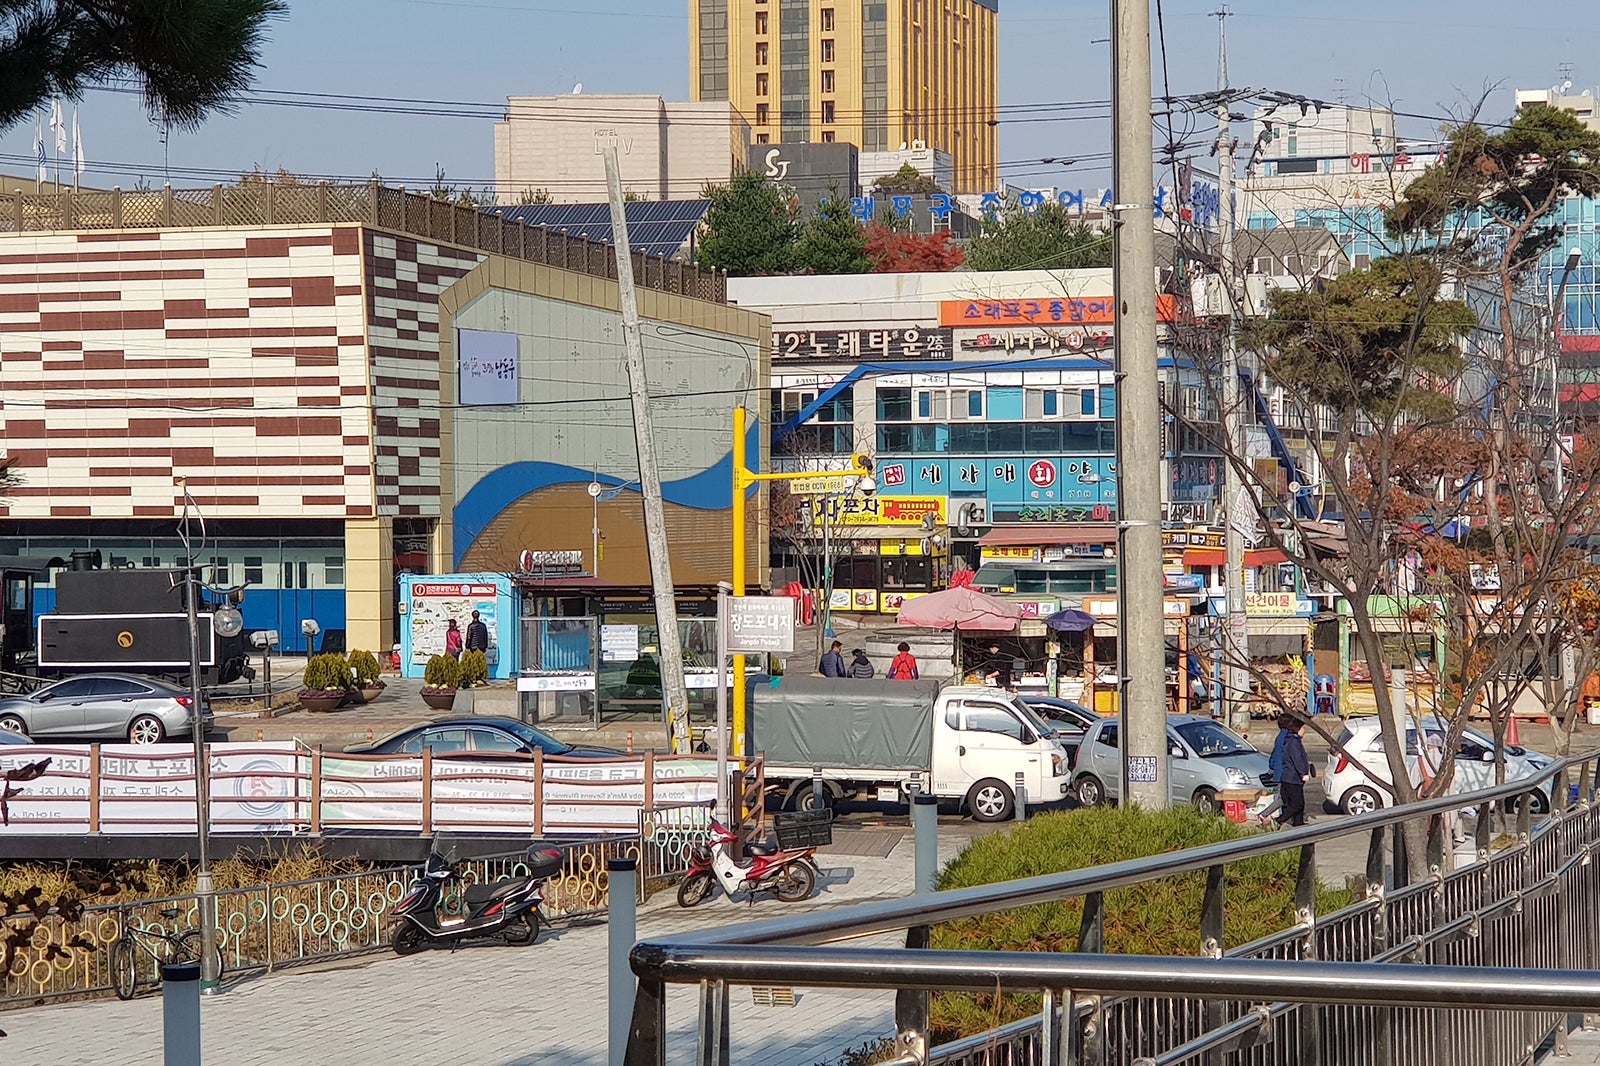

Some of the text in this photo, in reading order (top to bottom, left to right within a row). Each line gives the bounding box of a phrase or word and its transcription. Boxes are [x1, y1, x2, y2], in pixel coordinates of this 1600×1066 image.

[594, 128, 618, 136] HOTEL
[963, 301, 1115, 320] 소래포구 종합어
[995, 330, 1060, 350] 세자매
[920, 461, 1017, 484] 세자매
[812, 482, 827, 490] CCTV
[730, 613, 791, 632] 장도포대지
